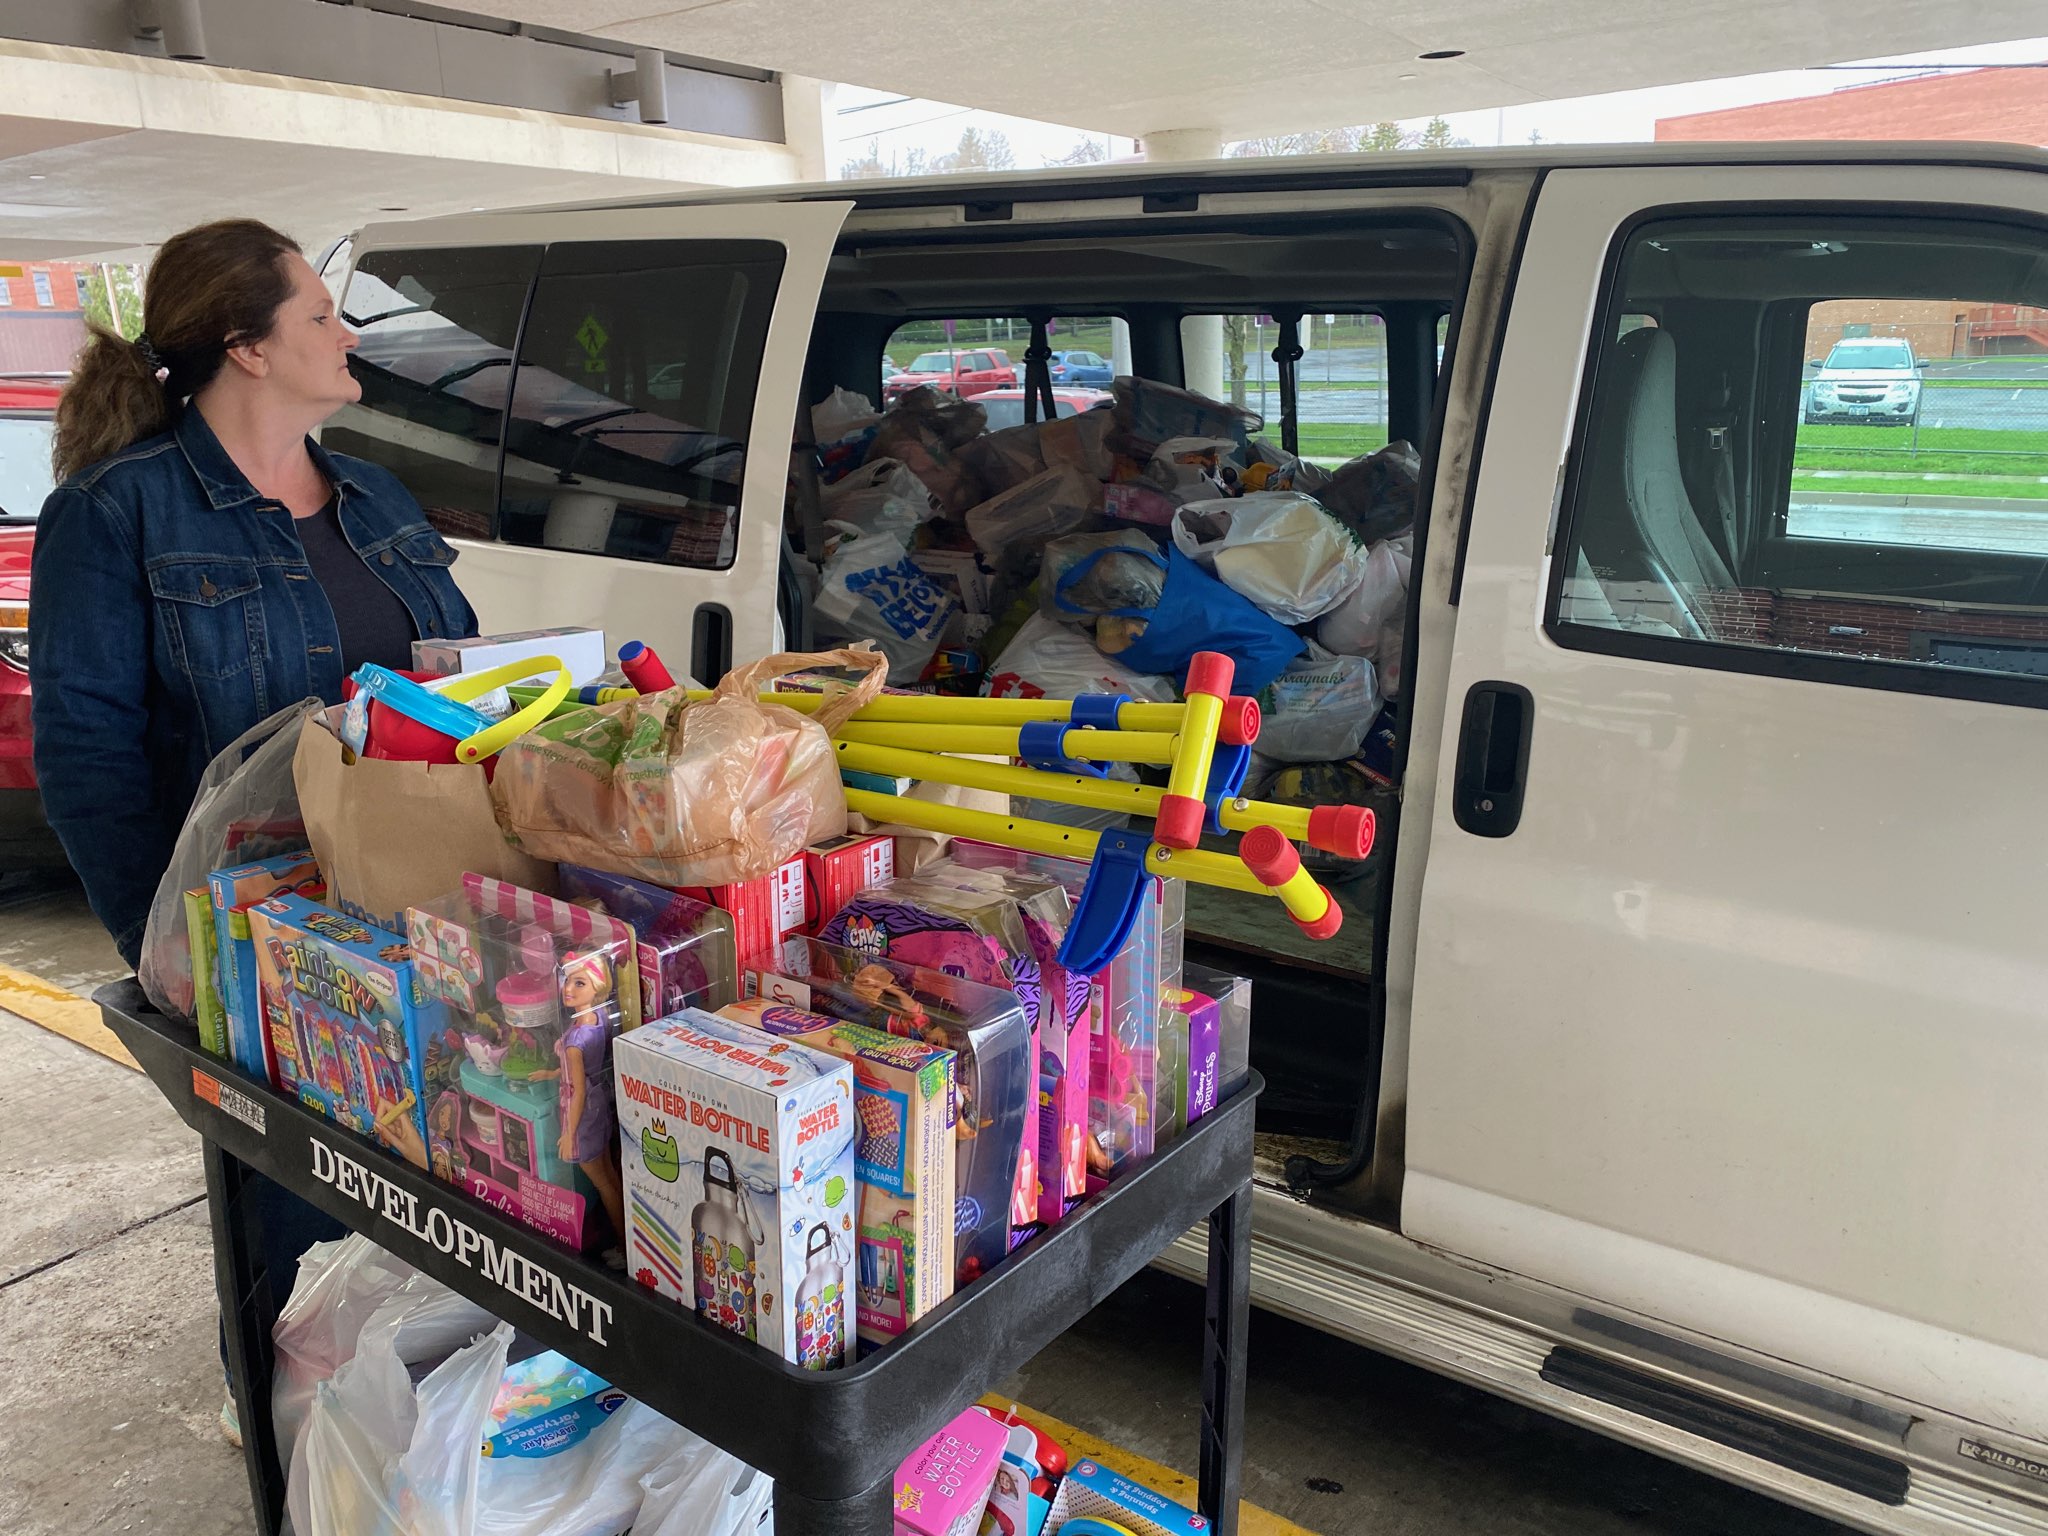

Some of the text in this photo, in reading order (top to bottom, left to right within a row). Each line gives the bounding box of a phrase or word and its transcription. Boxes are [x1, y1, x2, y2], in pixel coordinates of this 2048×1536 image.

[543, 747, 568, 763] steps
[300, 912, 374, 944] Rainbow
[304, 920, 354, 943] Loom
[850, 928, 885, 947] CAVE
[265, 935, 378, 1015] Rainbow
[291, 964, 361, 1019] Loom
[663, 1026, 791, 1076] WATER BOTTLE
[890, 1056, 918, 1069] made
[947, 1061, 956, 1094] made
[1194, 1072, 1206, 1110] Disney
[1202, 1052, 1216, 1116] PRINCESS
[302, 1093, 326, 1114] 1200
[658, 1079, 729, 1110] COLOR YOUR OWN
[621, 1073, 770, 1153] WATER BOTTLE
[799, 1103, 838, 1131] WATER
[946, 1102, 955, 1124] me!
[797, 1114, 840, 1146] BOTTLE
[309, 1136, 613, 1346] DEVELOPMENT
[870, 1313, 892, 1329] MORE!
[522, 1423, 578, 1450] BABY SHARK
[914, 1431, 947, 1475] color your own
[923, 1436, 963, 1484] WATER
[938, 1442, 982, 1498] BOTTLE
[1112, 1477, 1168, 1509] Popping Pals
[1118, 1491, 1159, 1515] Spinning
